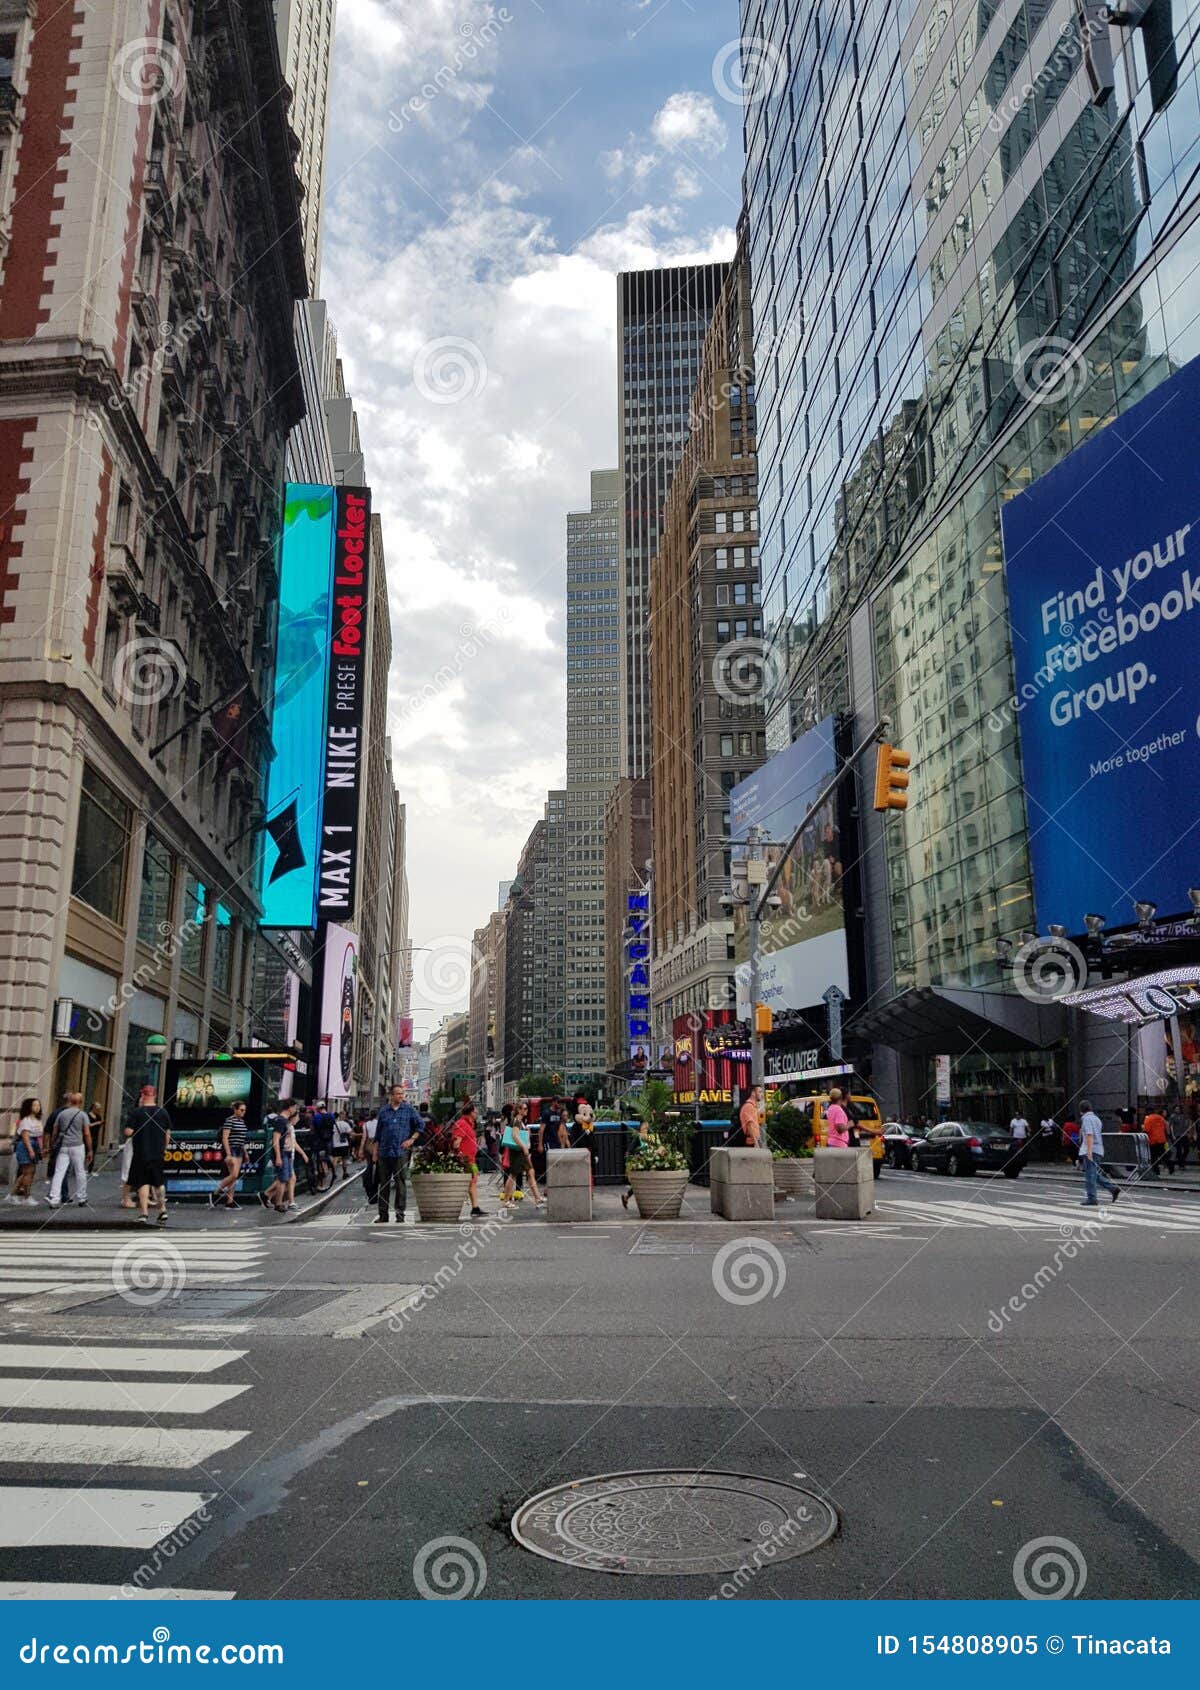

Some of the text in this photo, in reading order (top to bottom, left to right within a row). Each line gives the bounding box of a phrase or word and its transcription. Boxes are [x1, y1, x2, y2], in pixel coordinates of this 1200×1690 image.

[333, 494, 366, 655] Foot Locker
[1041, 523, 1191, 635] Find your
[1046, 569, 1200, 681] Facebook
[1050, 662, 1157, 727] Group.
[327, 726, 357, 788] NIKE
[1090, 729, 1187, 778] More together
[320, 850, 352, 907] MAX
[760, 984, 784, 1002] ogether
[768, 1056, 782, 1075] THE
[782, 1049, 819, 1073] COUNTER
